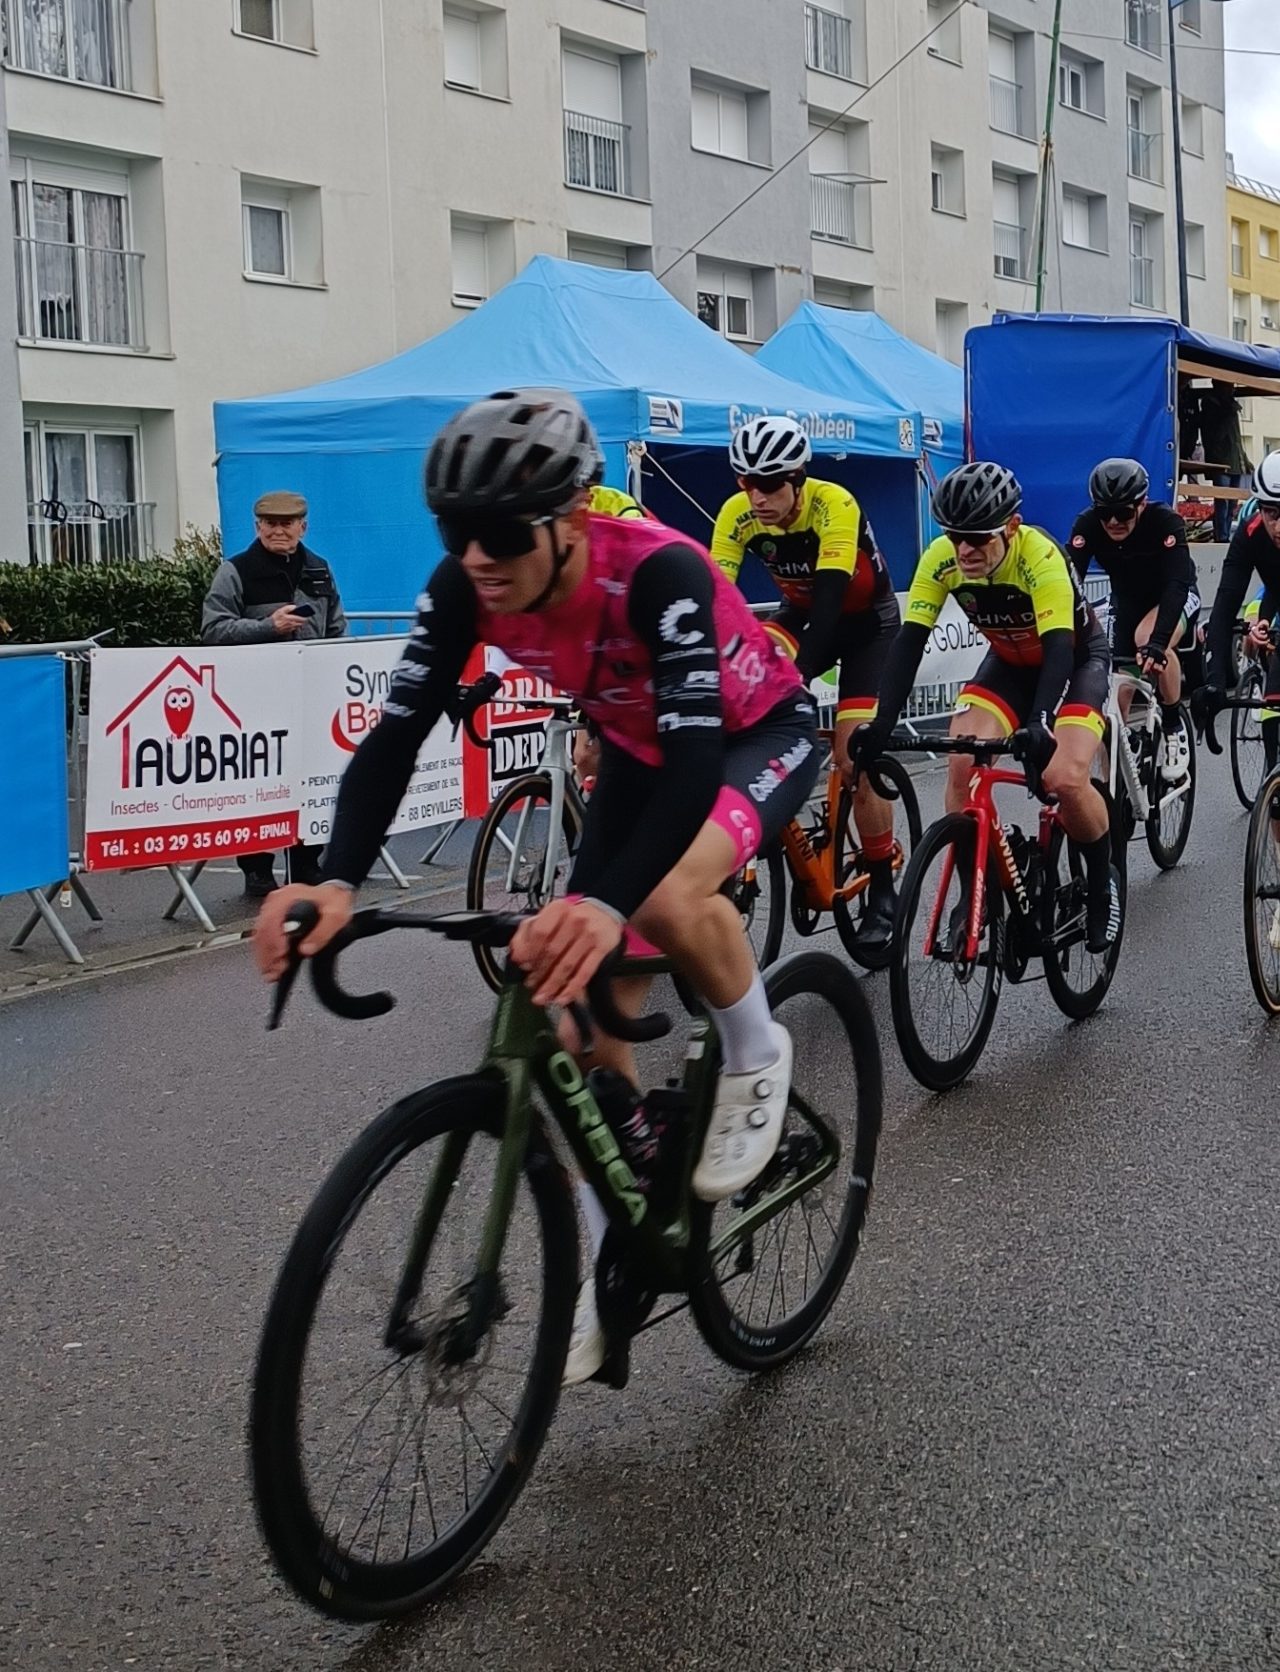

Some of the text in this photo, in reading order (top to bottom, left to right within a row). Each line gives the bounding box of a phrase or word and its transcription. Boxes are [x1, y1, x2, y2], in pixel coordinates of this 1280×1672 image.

[932, 621, 988, 652] GOLBE
[111, 784, 291, 816] Insectes Champignons Humidité
[421, 796, 463, 818] DEYVILLERS
[144, 836, 164, 854] 03
[168, 834, 188, 851] 29
[193, 832, 211, 849] 35
[215, 830, 232, 846] 60
[234, 827, 250, 843] 99
[260, 821, 291, 840] EPINAL
[310, 820, 330, 836] 06
